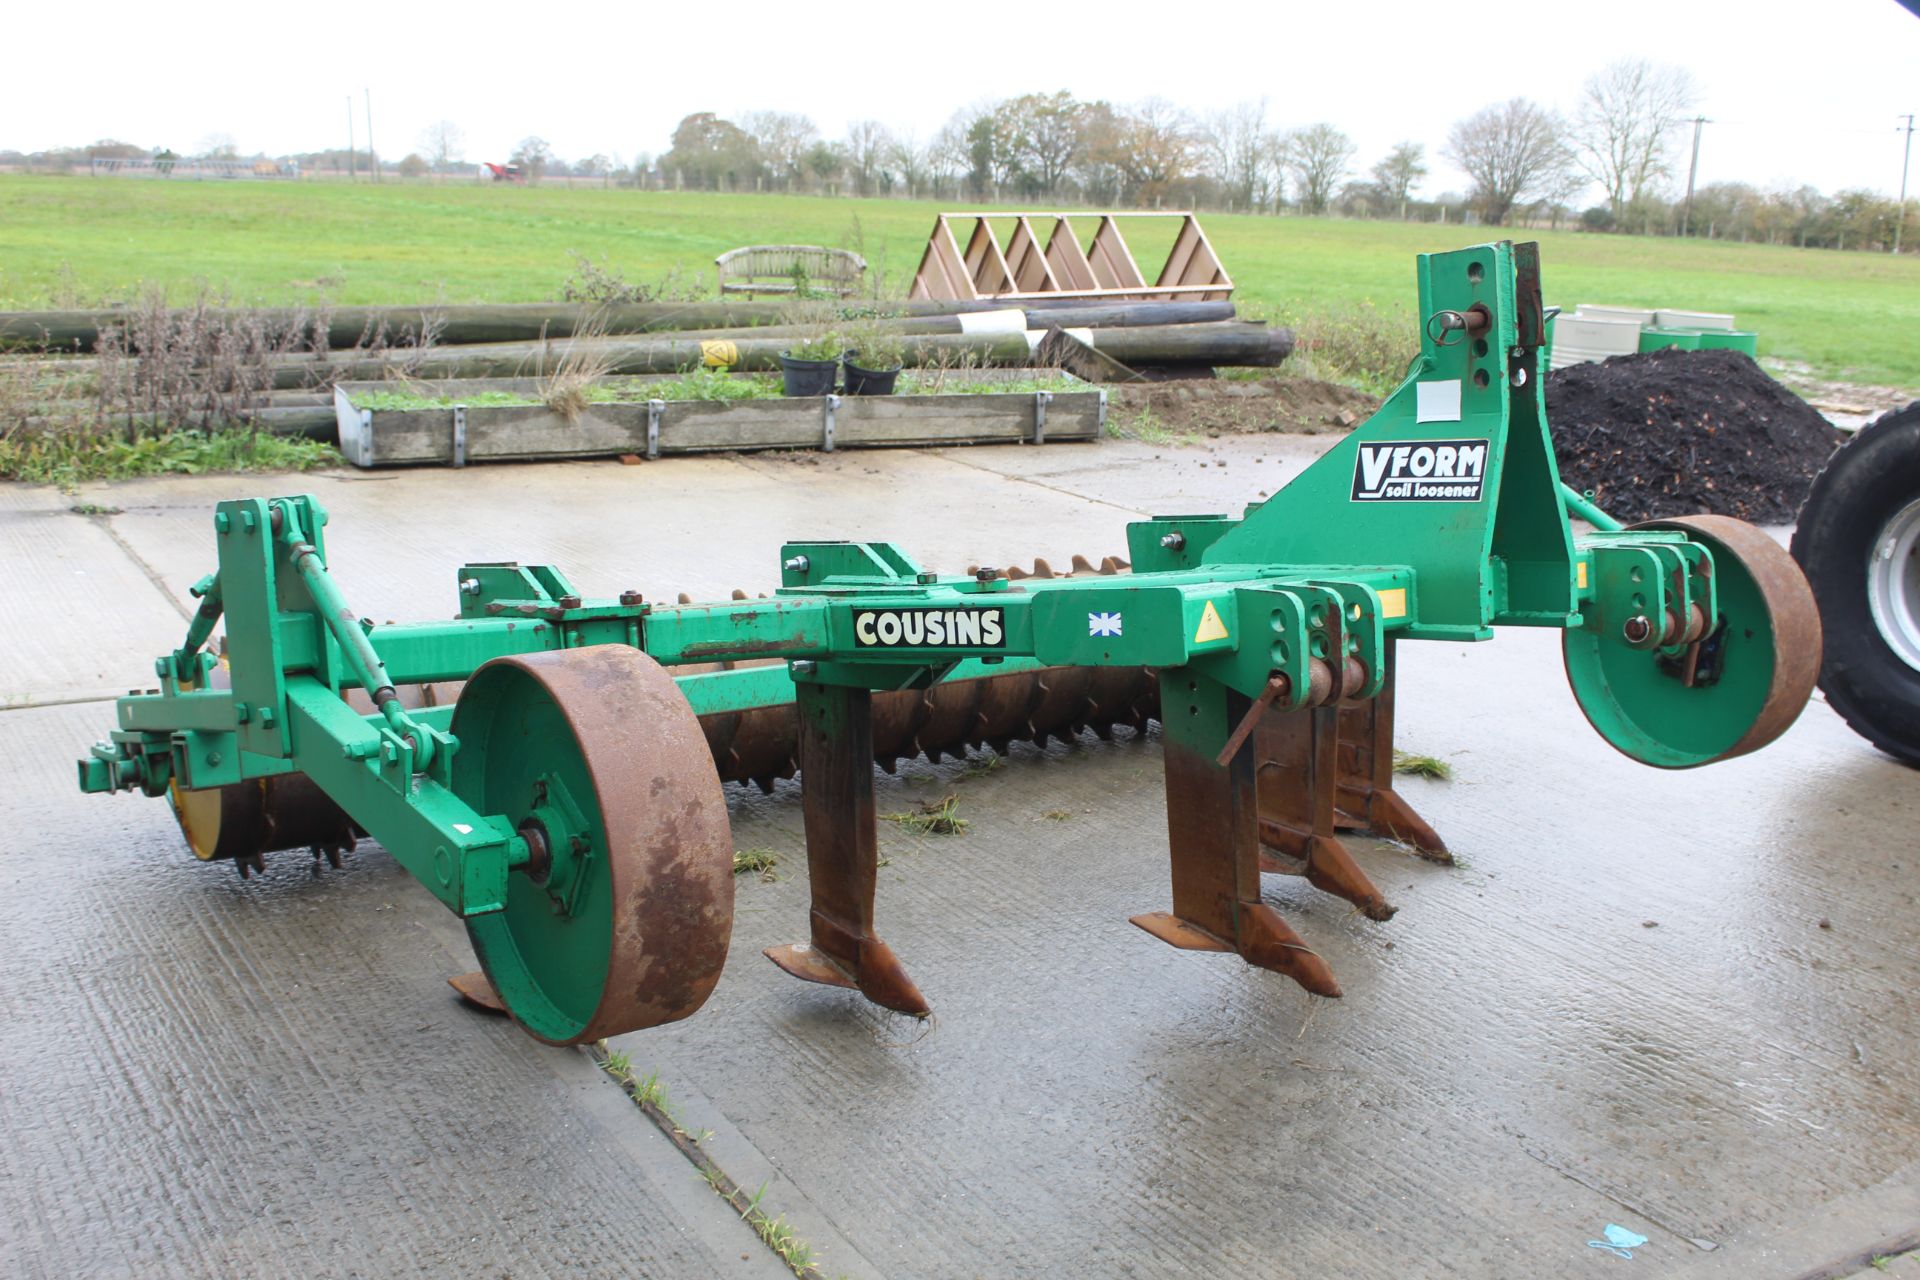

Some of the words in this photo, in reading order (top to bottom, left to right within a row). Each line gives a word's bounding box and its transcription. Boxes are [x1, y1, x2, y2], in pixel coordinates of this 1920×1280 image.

[1385, 483, 1411, 498] soil
[1414, 483, 1479, 498] loosener
[856, 610, 1002, 645] COUSINS
